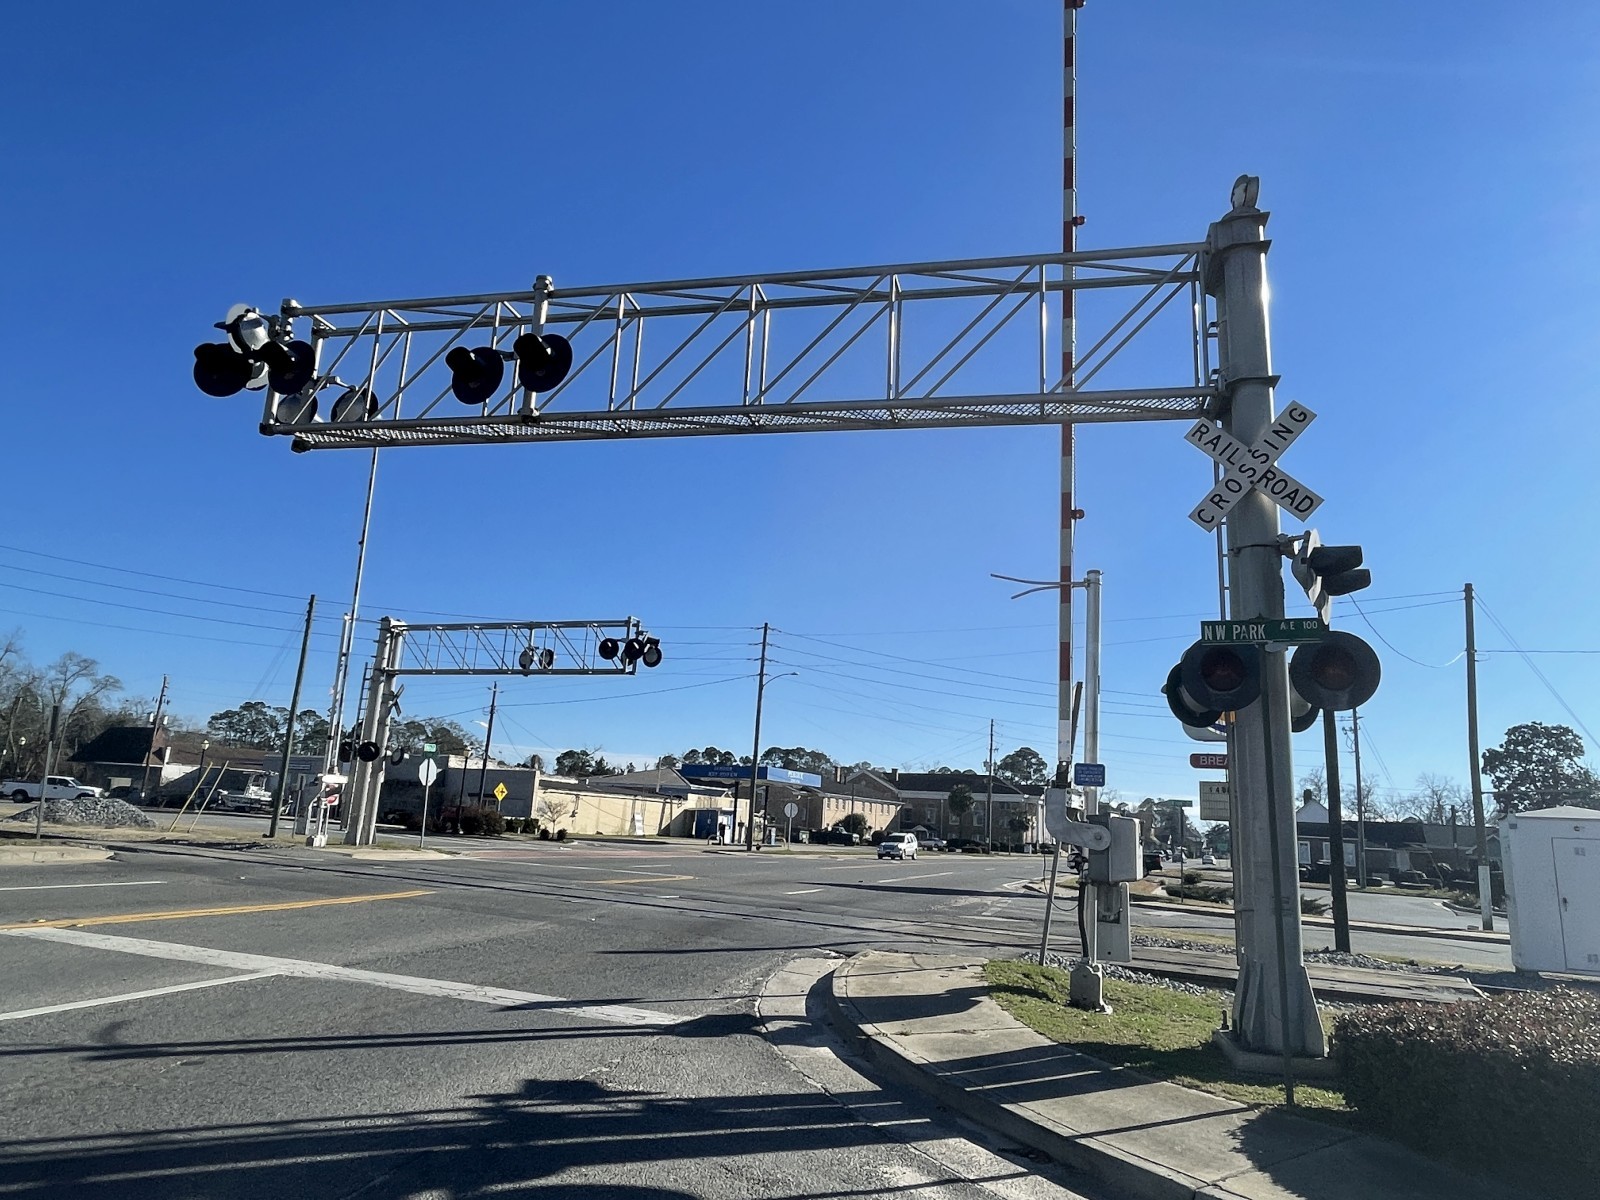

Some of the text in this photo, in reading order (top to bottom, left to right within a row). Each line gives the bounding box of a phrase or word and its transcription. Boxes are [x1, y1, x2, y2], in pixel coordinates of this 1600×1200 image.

[1197, 407, 1308, 524] CROSSING
[1232, 624, 1266, 640] PARK
[1302, 620, 1318, 629] 100
